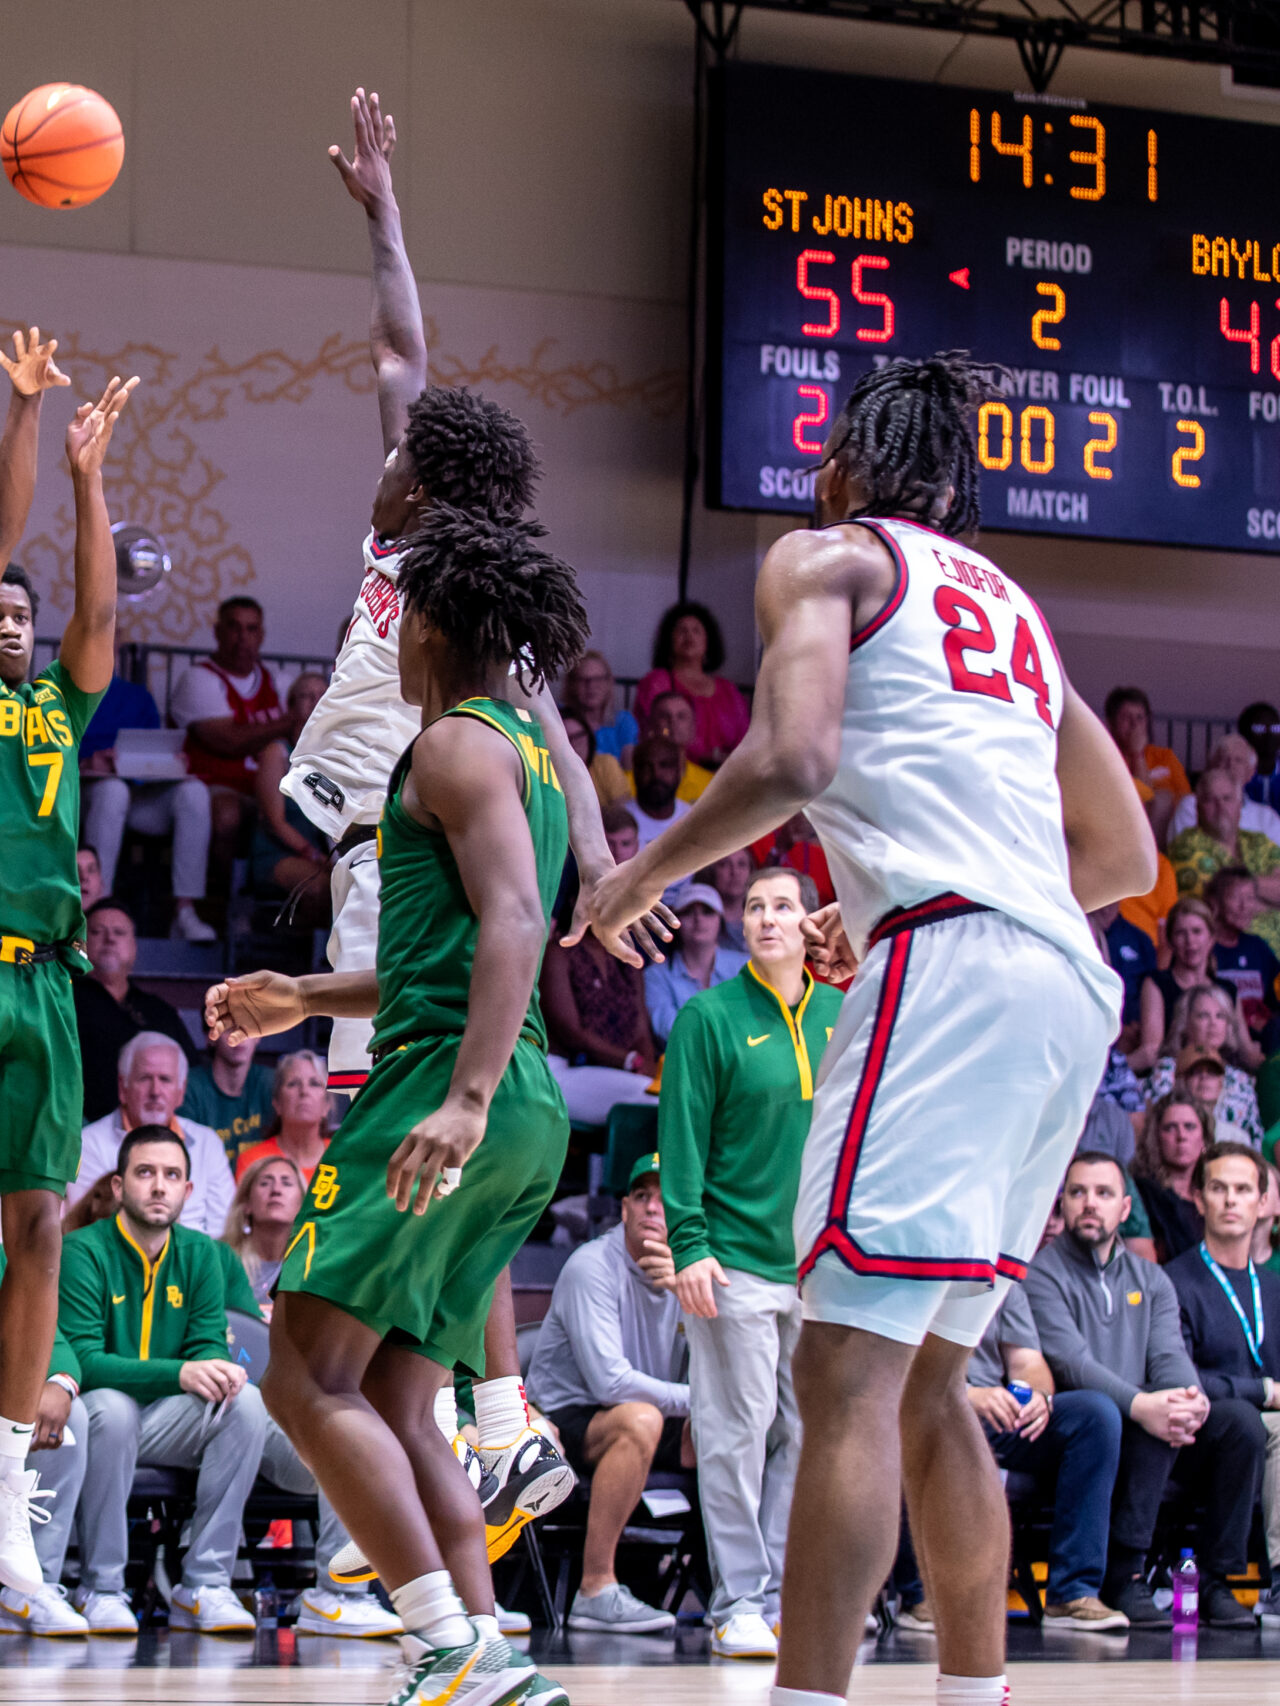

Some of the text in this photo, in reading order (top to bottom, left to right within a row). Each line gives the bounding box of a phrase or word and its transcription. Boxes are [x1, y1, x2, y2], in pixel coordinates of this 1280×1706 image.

[969, 107, 1159, 202] 14:31
[763, 188, 914, 244] ST JOHNS
[1006, 236, 1093, 275] PERIOD
[796, 249, 895, 343] 55
[1031, 281, 1066, 351] 2
[759, 344, 841, 382] FOULS
[1220, 297, 1280, 382] 4
[793, 384, 829, 454] 2
[971, 367, 1132, 409] AYER FOUL
[1158, 382, 1219, 417] T.O.L.
[978, 402, 1118, 480] 00 2
[1172, 419, 1206, 489] 2
[1007, 487, 1089, 524] MATCH
[932, 549, 1012, 605] EJIOFOR
[933, 585, 1056, 731] 24
[28, 752, 64, 817] 7
